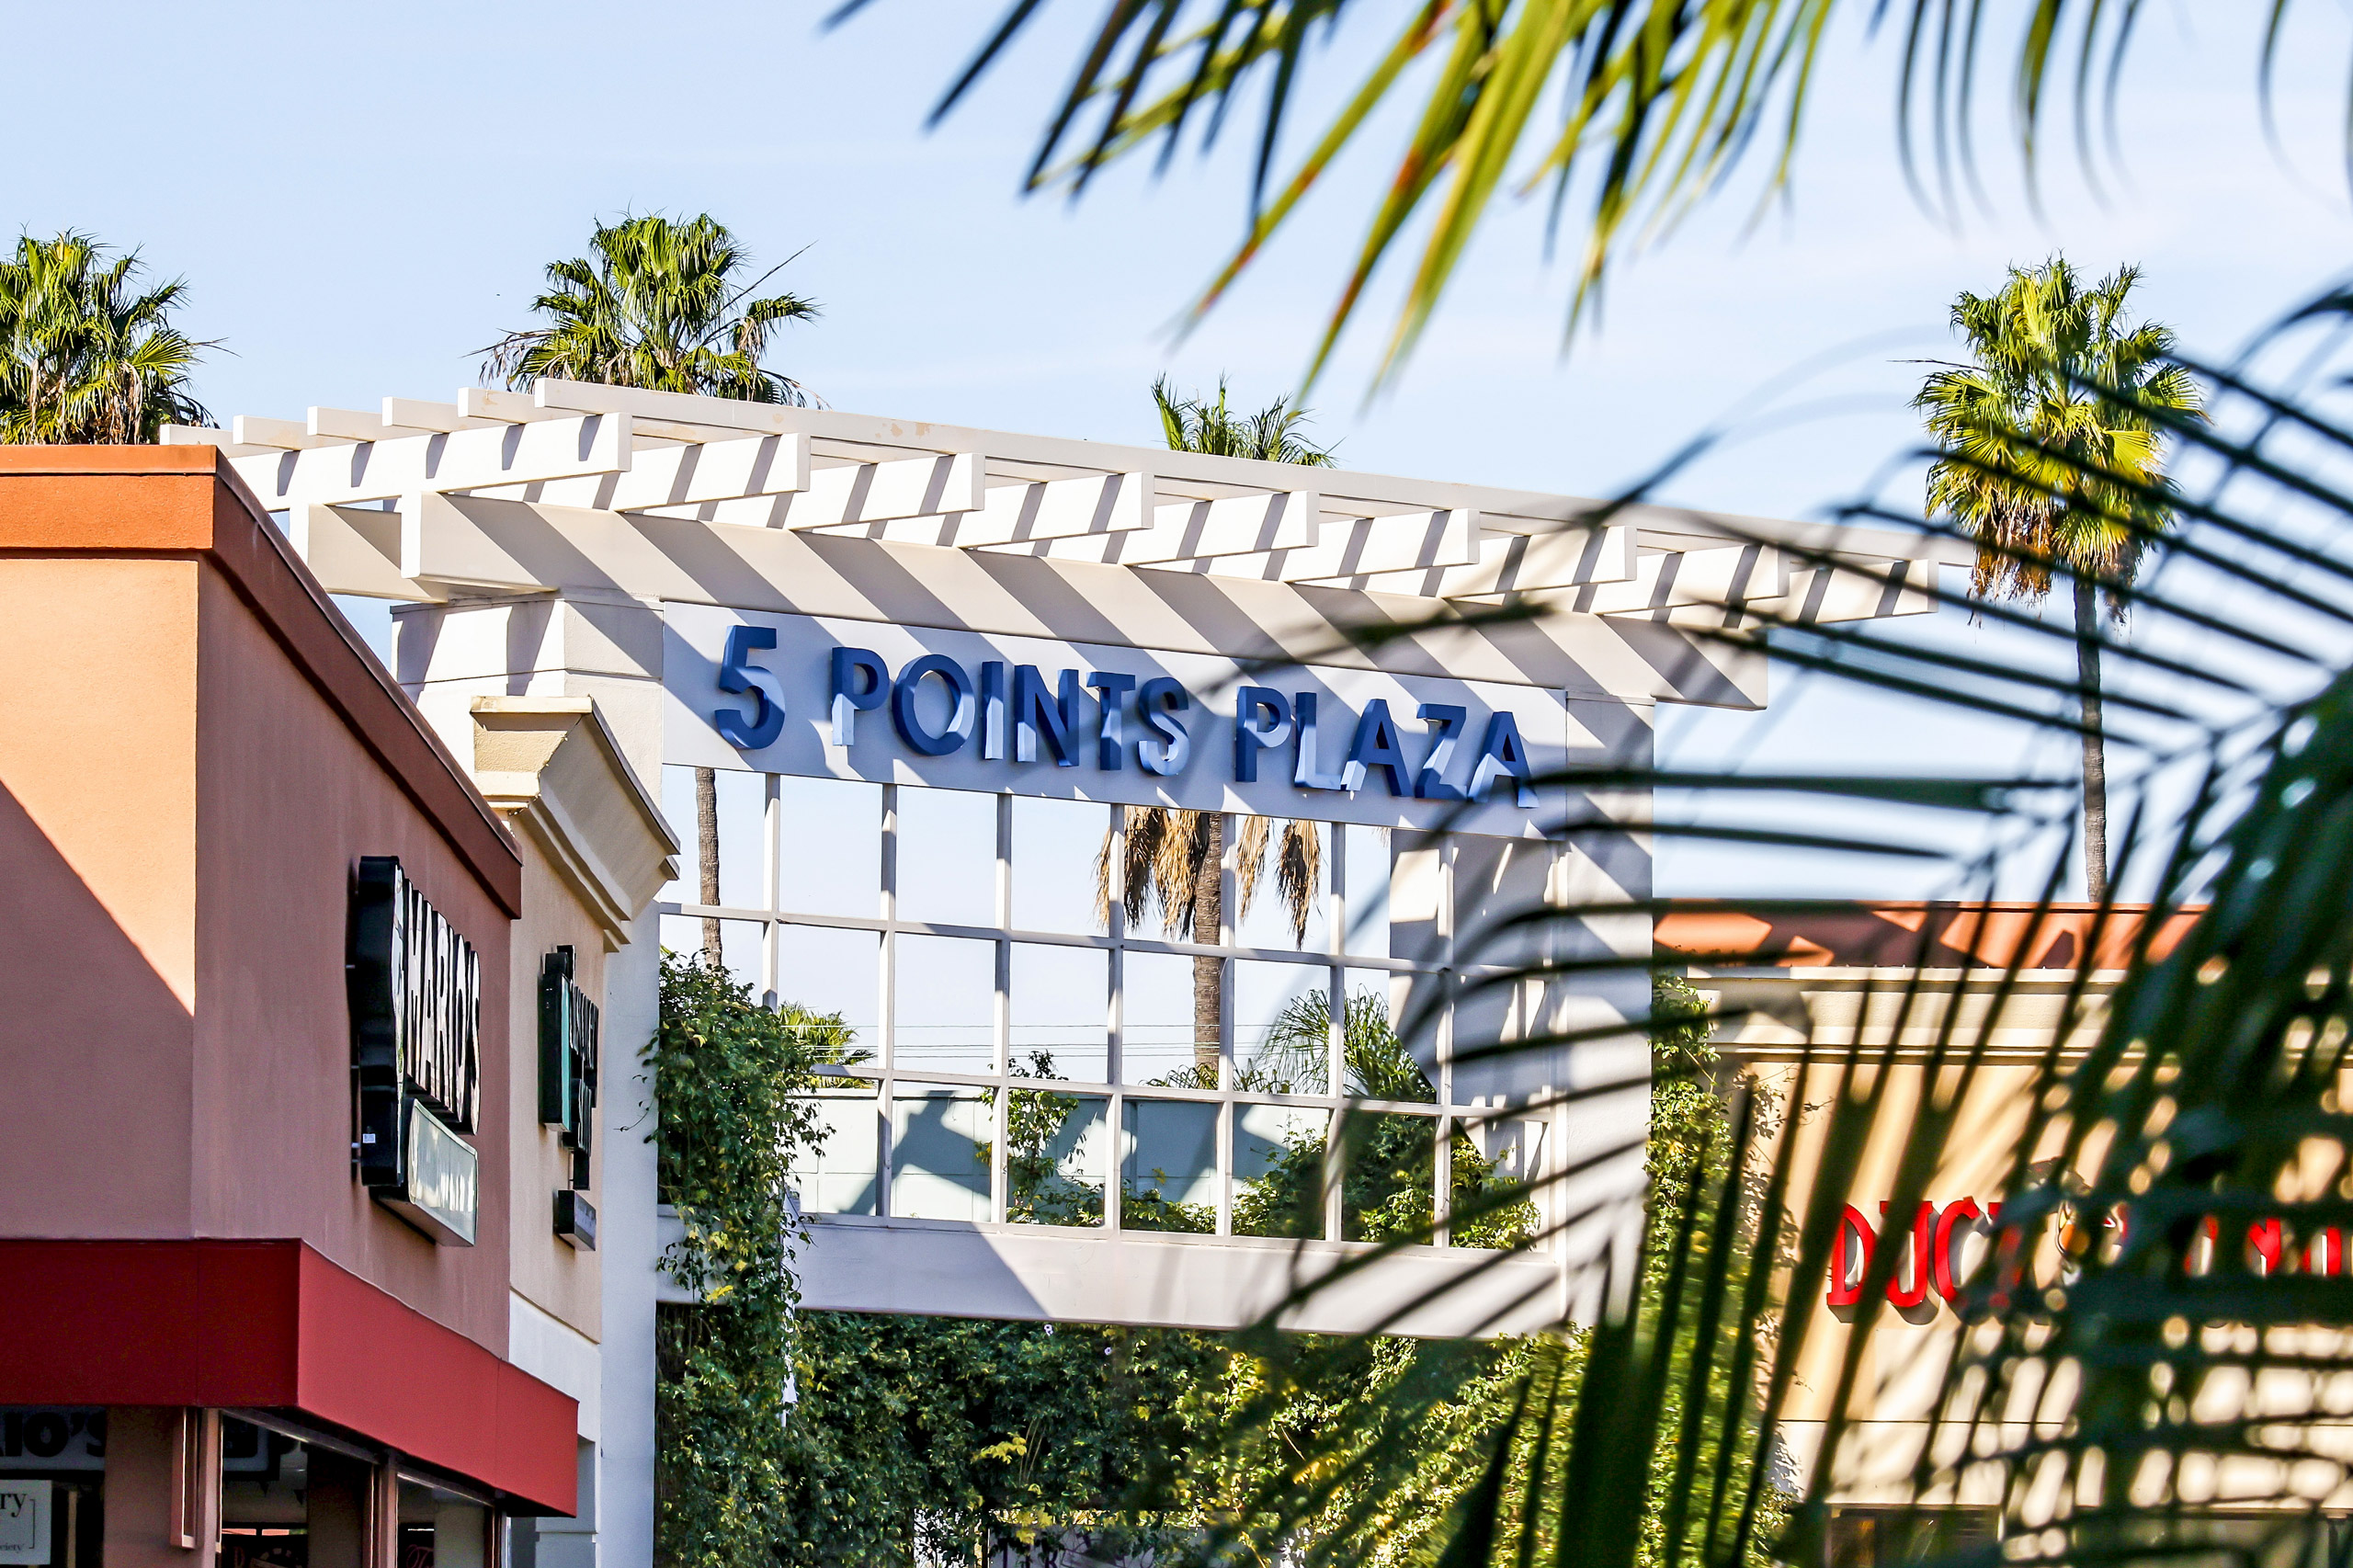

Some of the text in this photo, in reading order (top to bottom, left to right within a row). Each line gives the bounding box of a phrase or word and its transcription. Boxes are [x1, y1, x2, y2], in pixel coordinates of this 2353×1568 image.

[715, 625, 1540, 809] 5 POINTS PLAZA
[406, 879, 481, 1135] MARIO'S
[1826, 1196, 2023, 1309] DUC
[0, 1411, 105, 1457] IO'S
